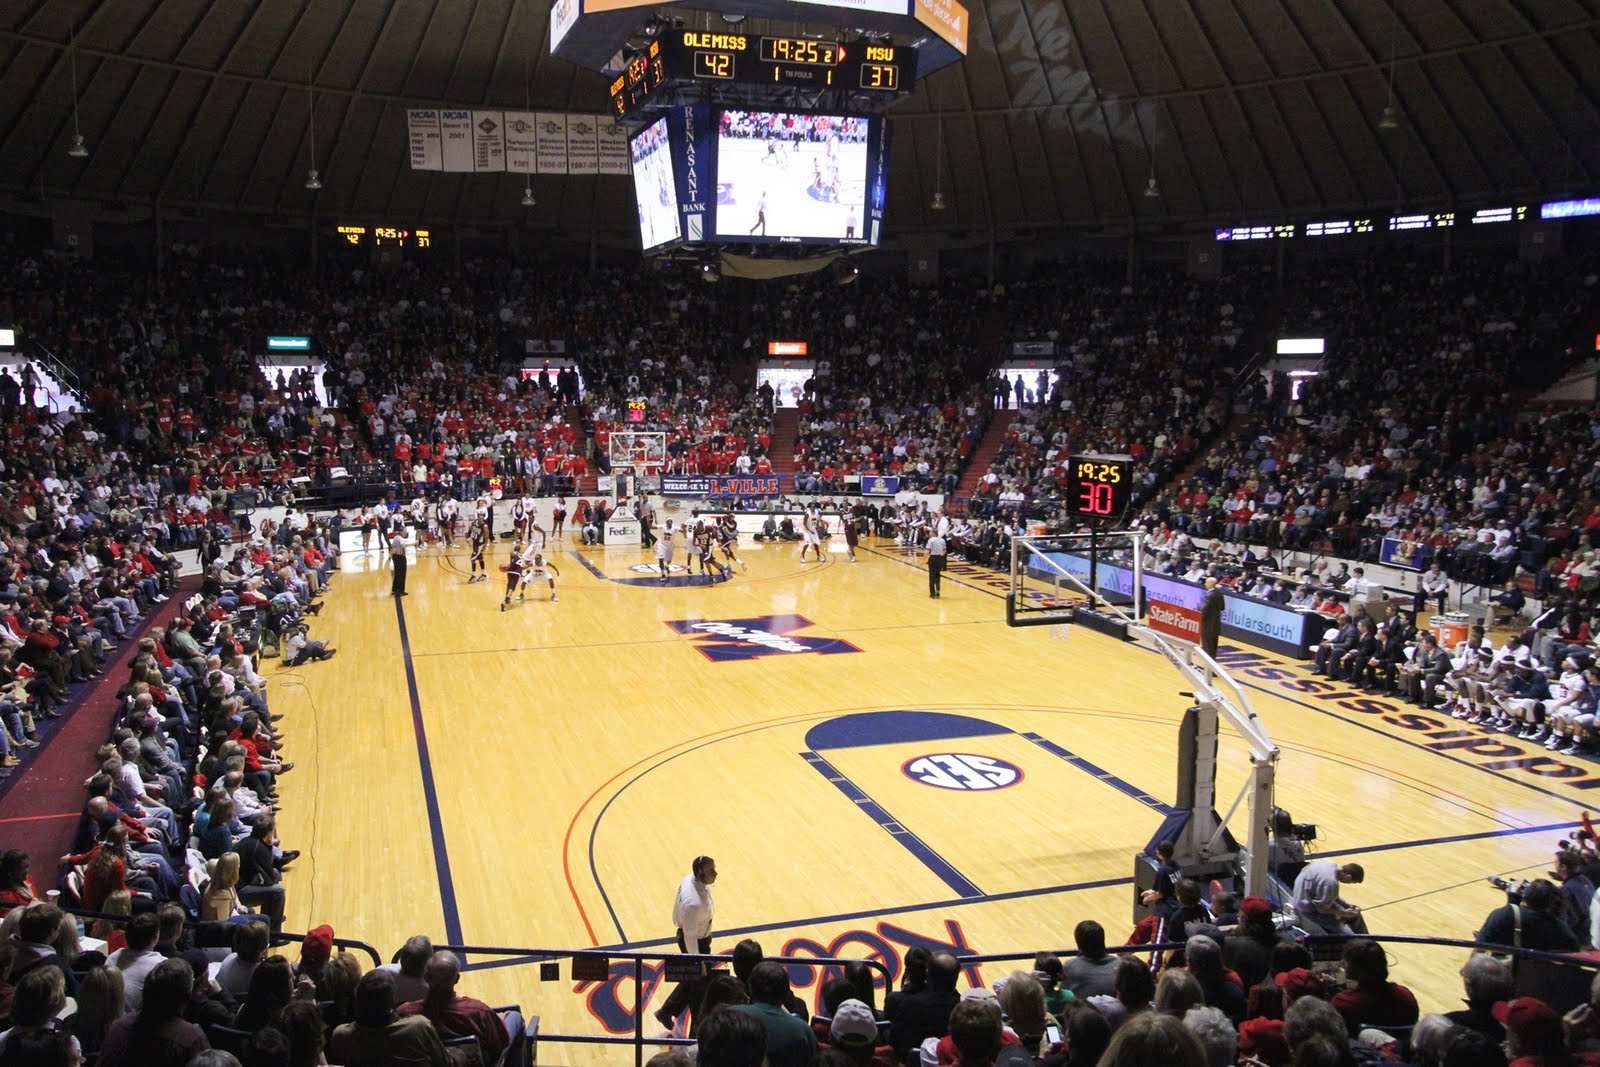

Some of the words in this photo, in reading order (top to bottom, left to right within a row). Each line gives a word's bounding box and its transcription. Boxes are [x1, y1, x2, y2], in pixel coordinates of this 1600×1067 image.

[773, 39, 818, 62] 19:25
[824, 50, 832, 63] 2
[866, 46, 894, 61] MSU
[705, 54, 729, 76] 42
[774, 66, 779, 81] 1
[827, 69, 832, 85] 1
[871, 66, 893, 87] 37
[410, 111, 436, 119] NCAA
[443, 111, 468, 119] NCAA
[684, 106, 698, 202] RENASANT
[682, 202, 706, 213] BANK
[346, 234, 359, 244] 42
[375, 227, 397, 238] 19:25
[418, 237, 430, 247] 37
[629, 409, 644, 421] 30
[1078, 462, 1121, 483] 19:25
[1079, 481, 1112, 514] 30
[609, 526, 636, 536] FedEx
[1220, 608, 1293, 641] ellularsouth
[909, 754, 1017, 790] SEC
